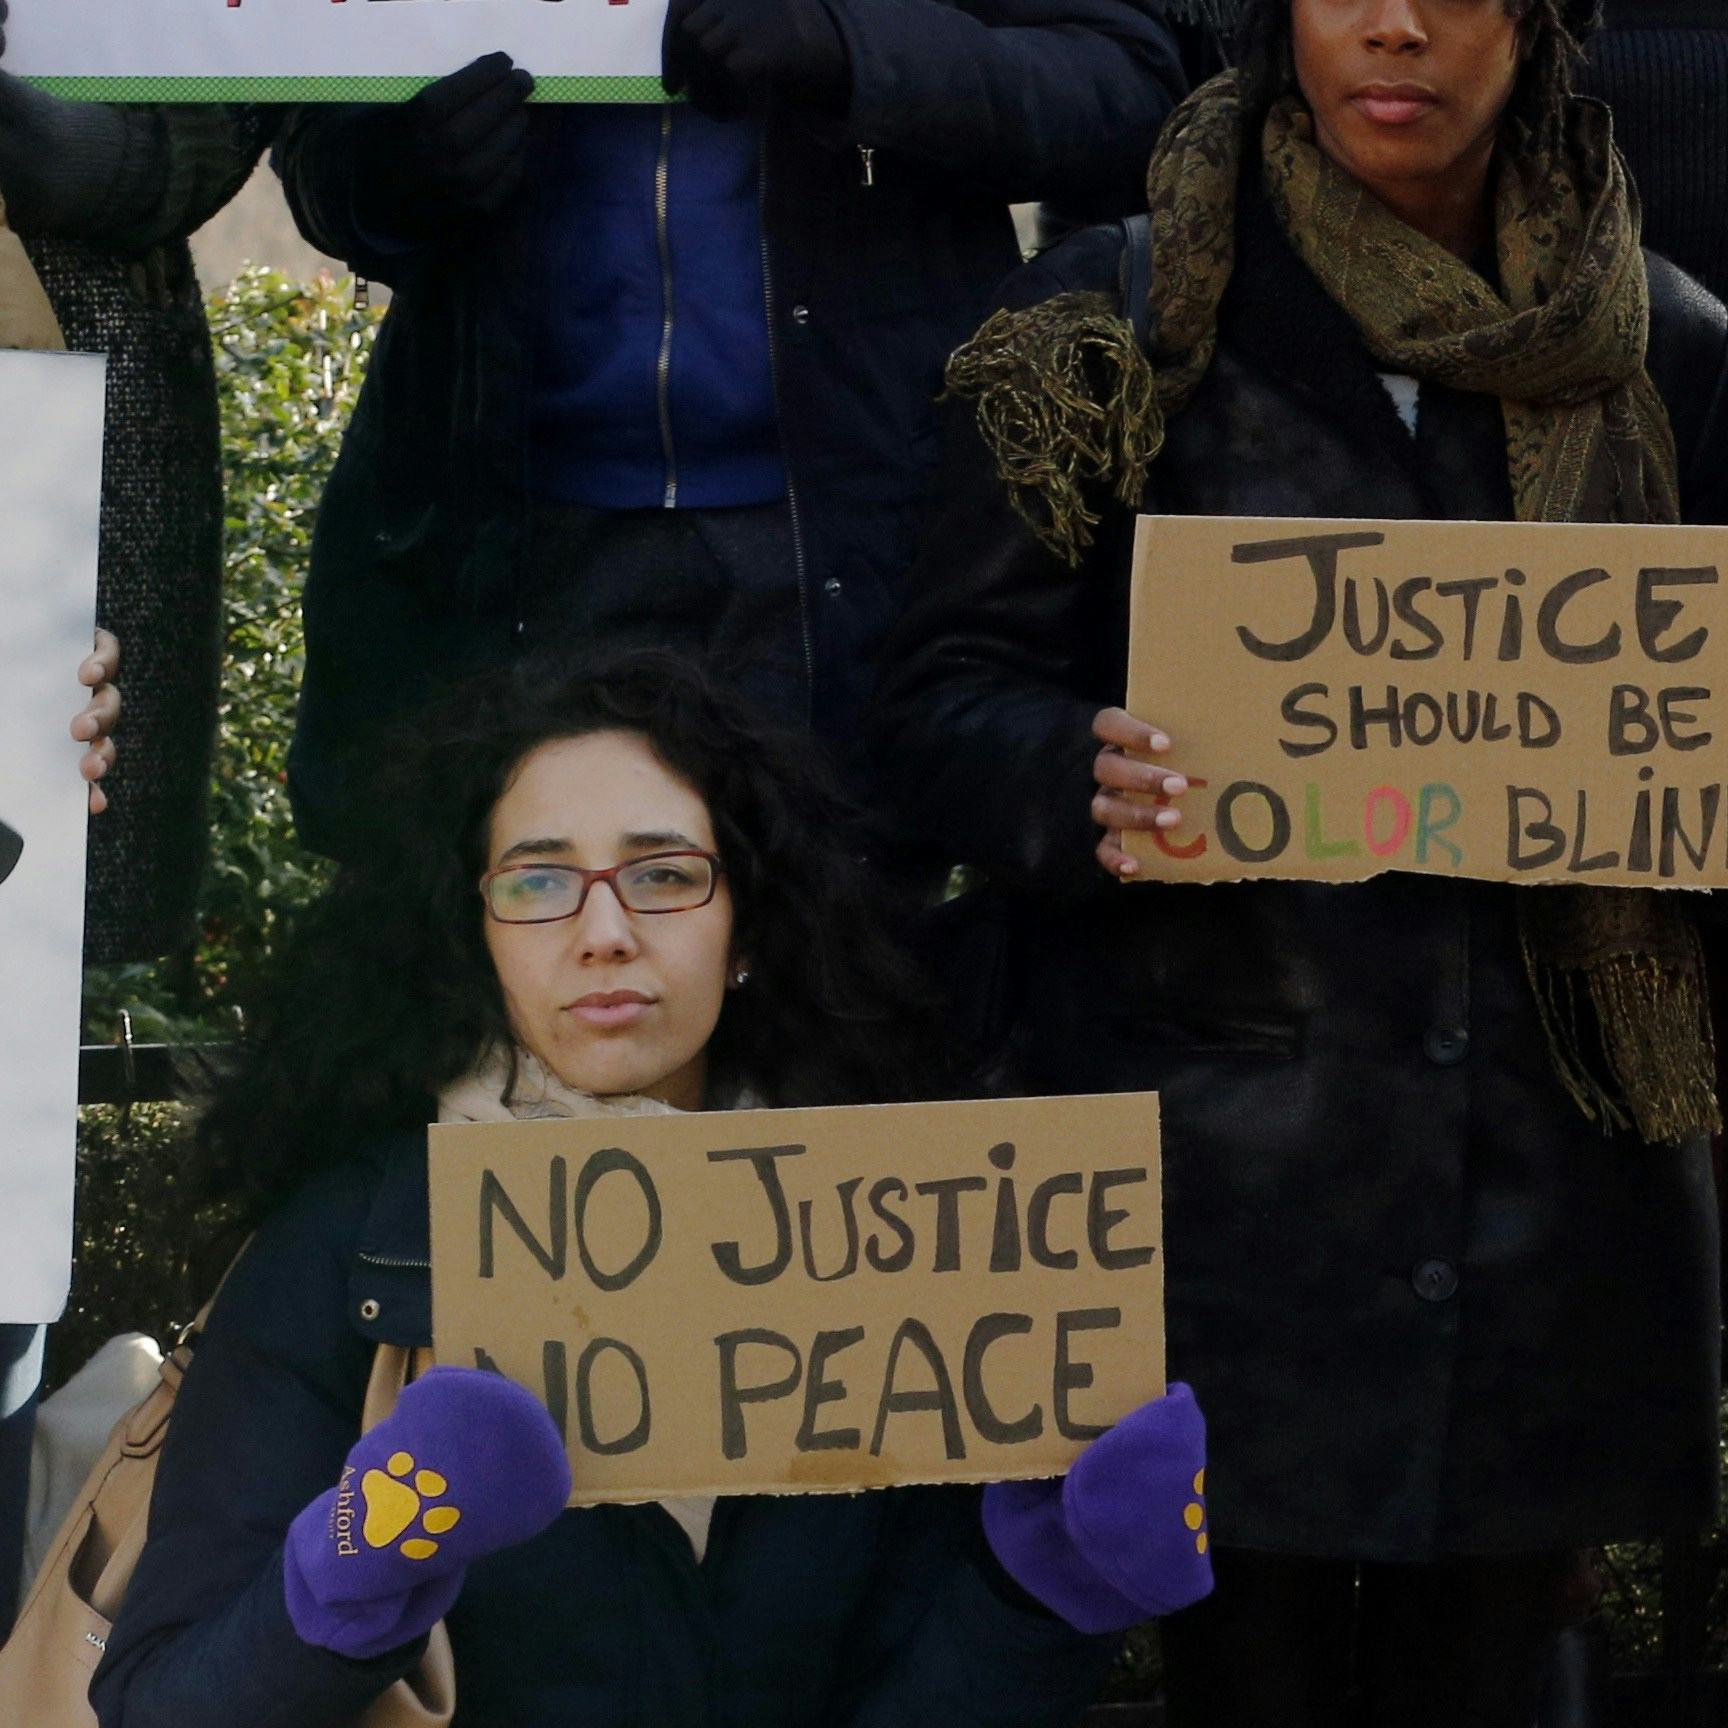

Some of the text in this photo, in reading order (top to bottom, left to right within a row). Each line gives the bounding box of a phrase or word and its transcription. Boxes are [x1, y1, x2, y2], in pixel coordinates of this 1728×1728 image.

[1231, 531, 1719, 664] JUSTICE
[1277, 682, 1711, 758] SHOULD BE
[478, 1141, 1156, 1292] NO JUSTICE
[713, 1306, 1121, 1461] PEACE
